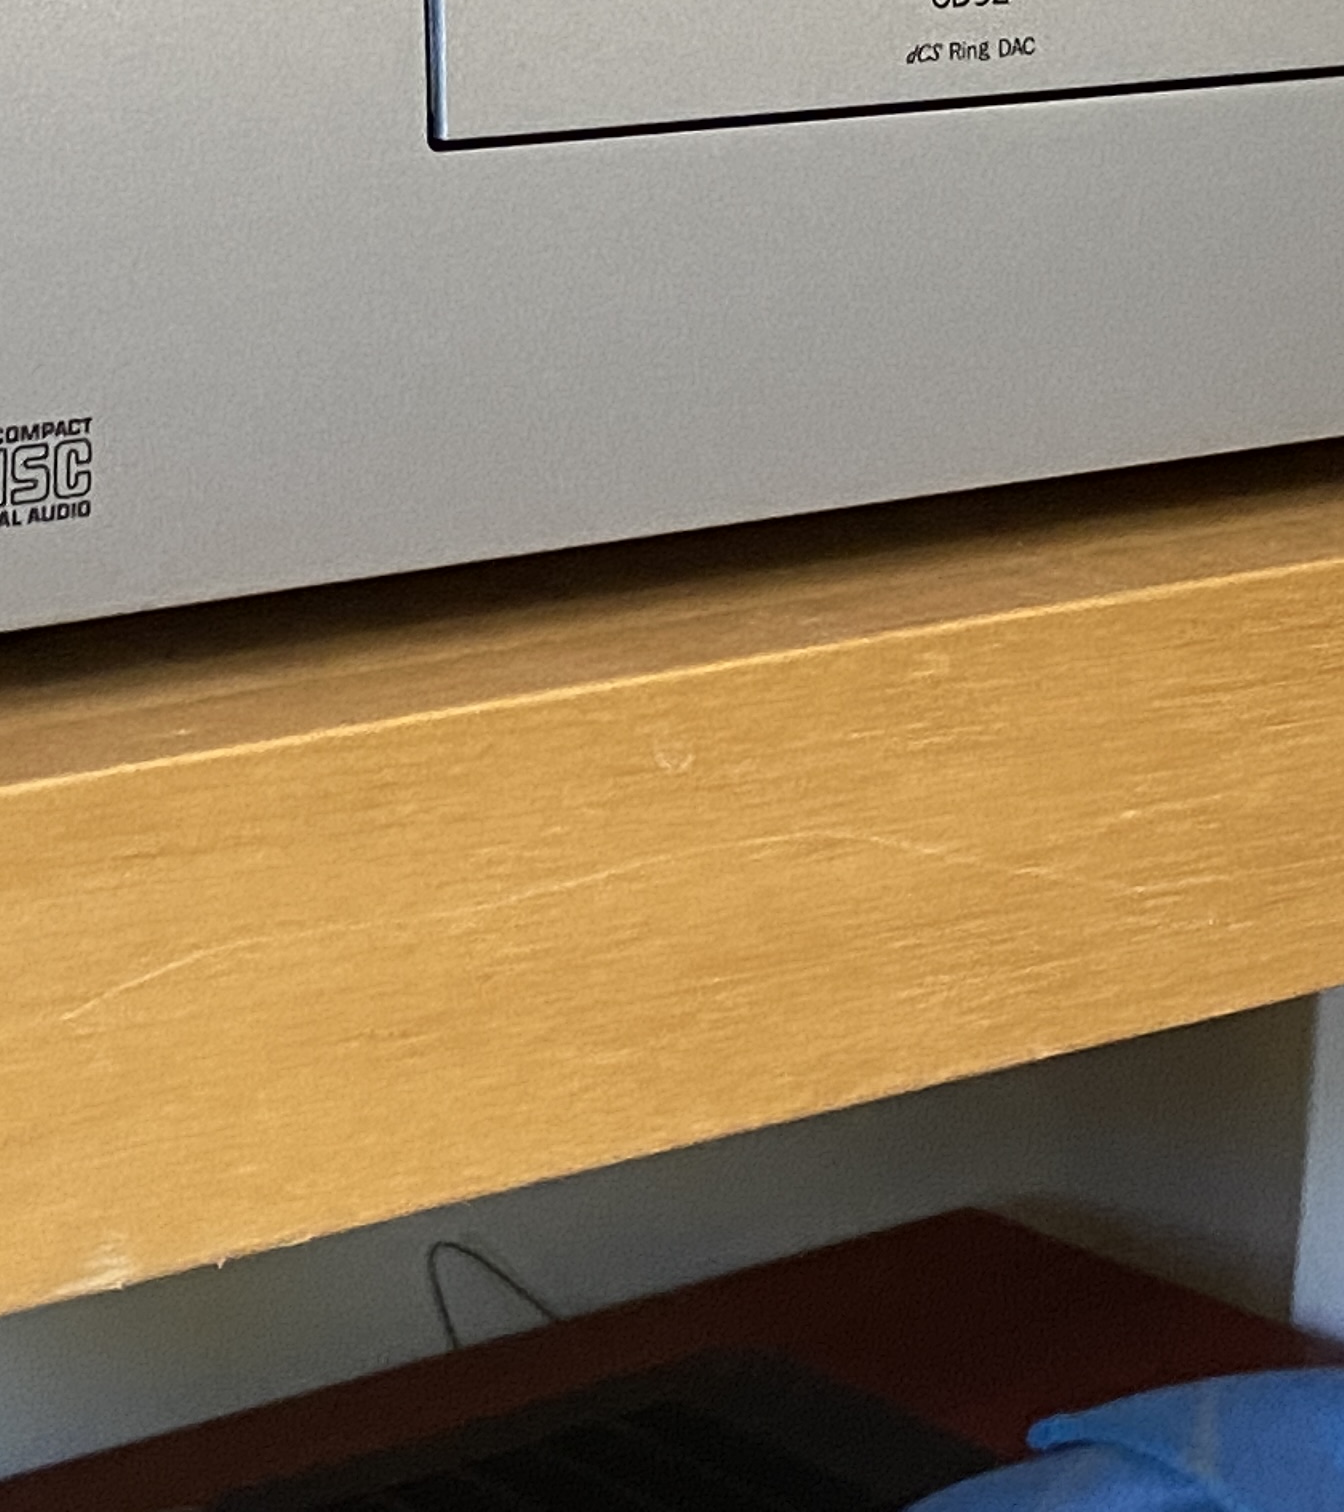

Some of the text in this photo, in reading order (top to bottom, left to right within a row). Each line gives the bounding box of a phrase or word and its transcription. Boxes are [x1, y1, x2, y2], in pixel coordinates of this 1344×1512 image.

[949, 40, 990, 62] Ring
[998, 36, 1036, 57] DAC
[27, 499, 92, 525] AUDIO
